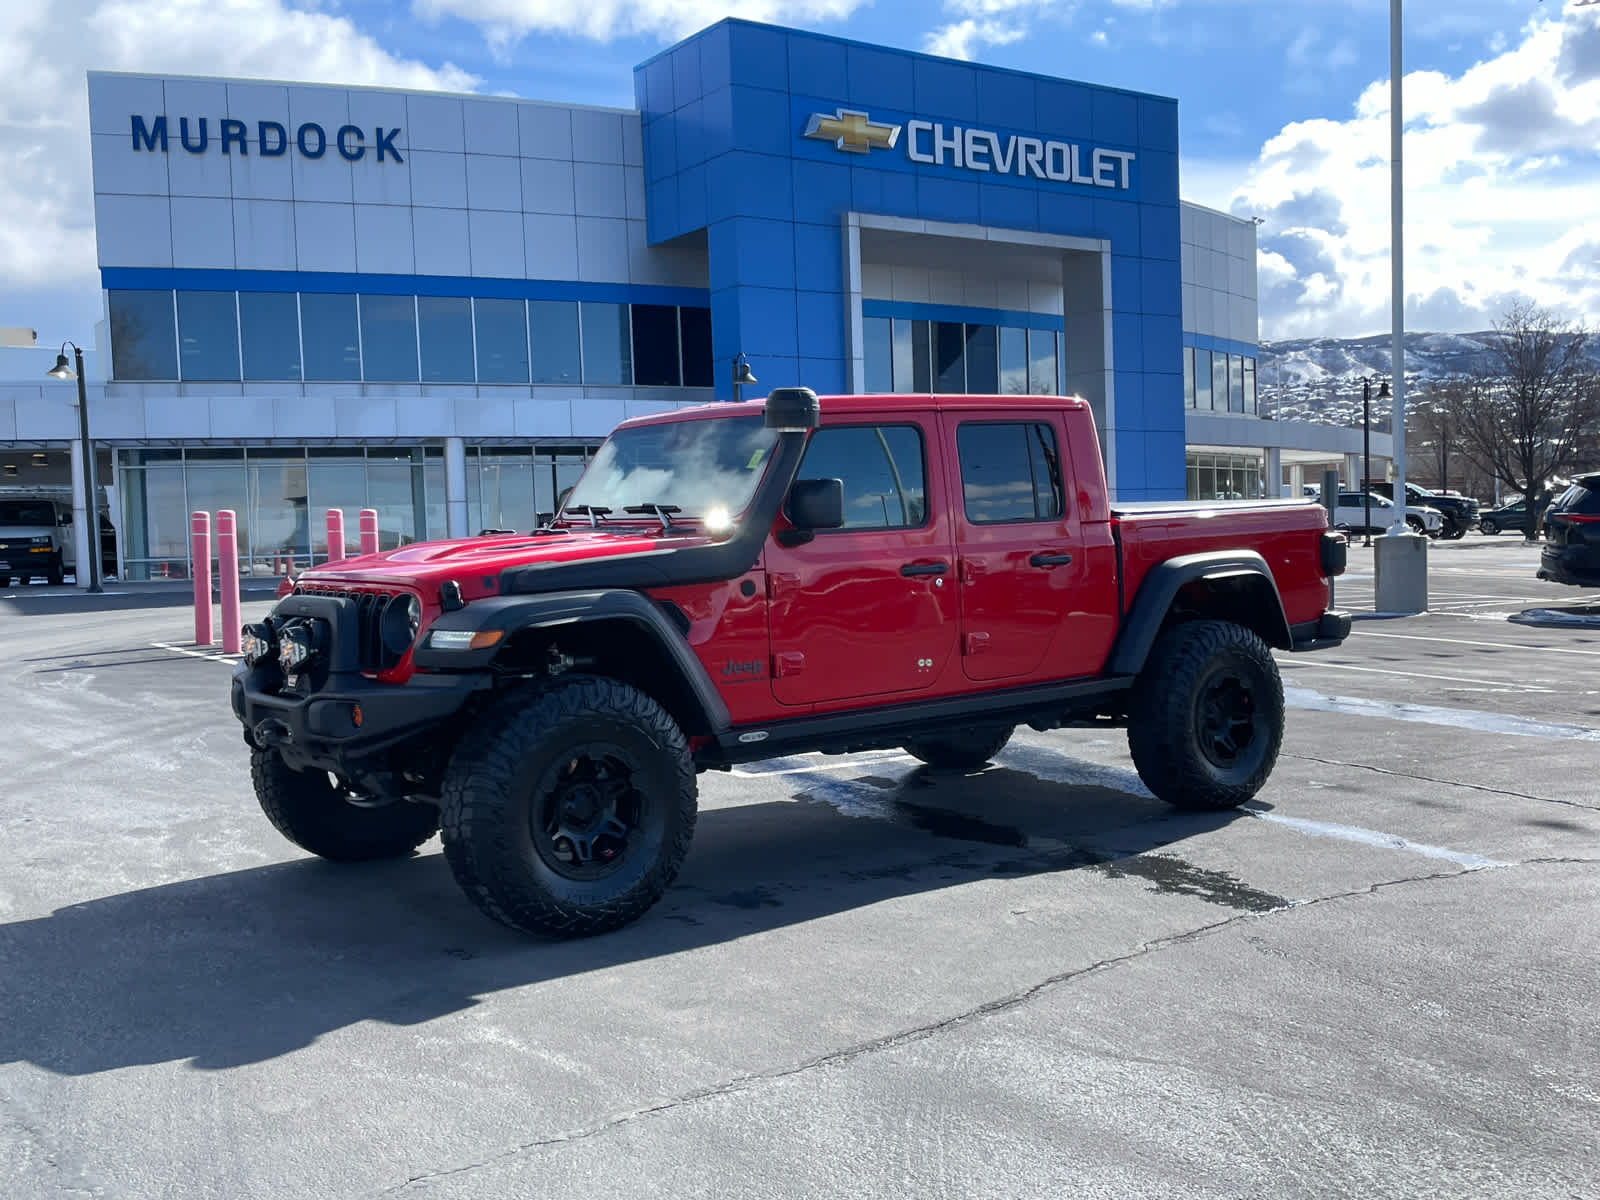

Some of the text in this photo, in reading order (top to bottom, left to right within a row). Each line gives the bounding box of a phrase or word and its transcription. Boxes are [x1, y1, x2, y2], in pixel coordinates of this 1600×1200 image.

[130, 115, 404, 164] MURDOCK
[907, 119, 1136, 190] CHEVROLET
[721, 658, 763, 676] Jeep
